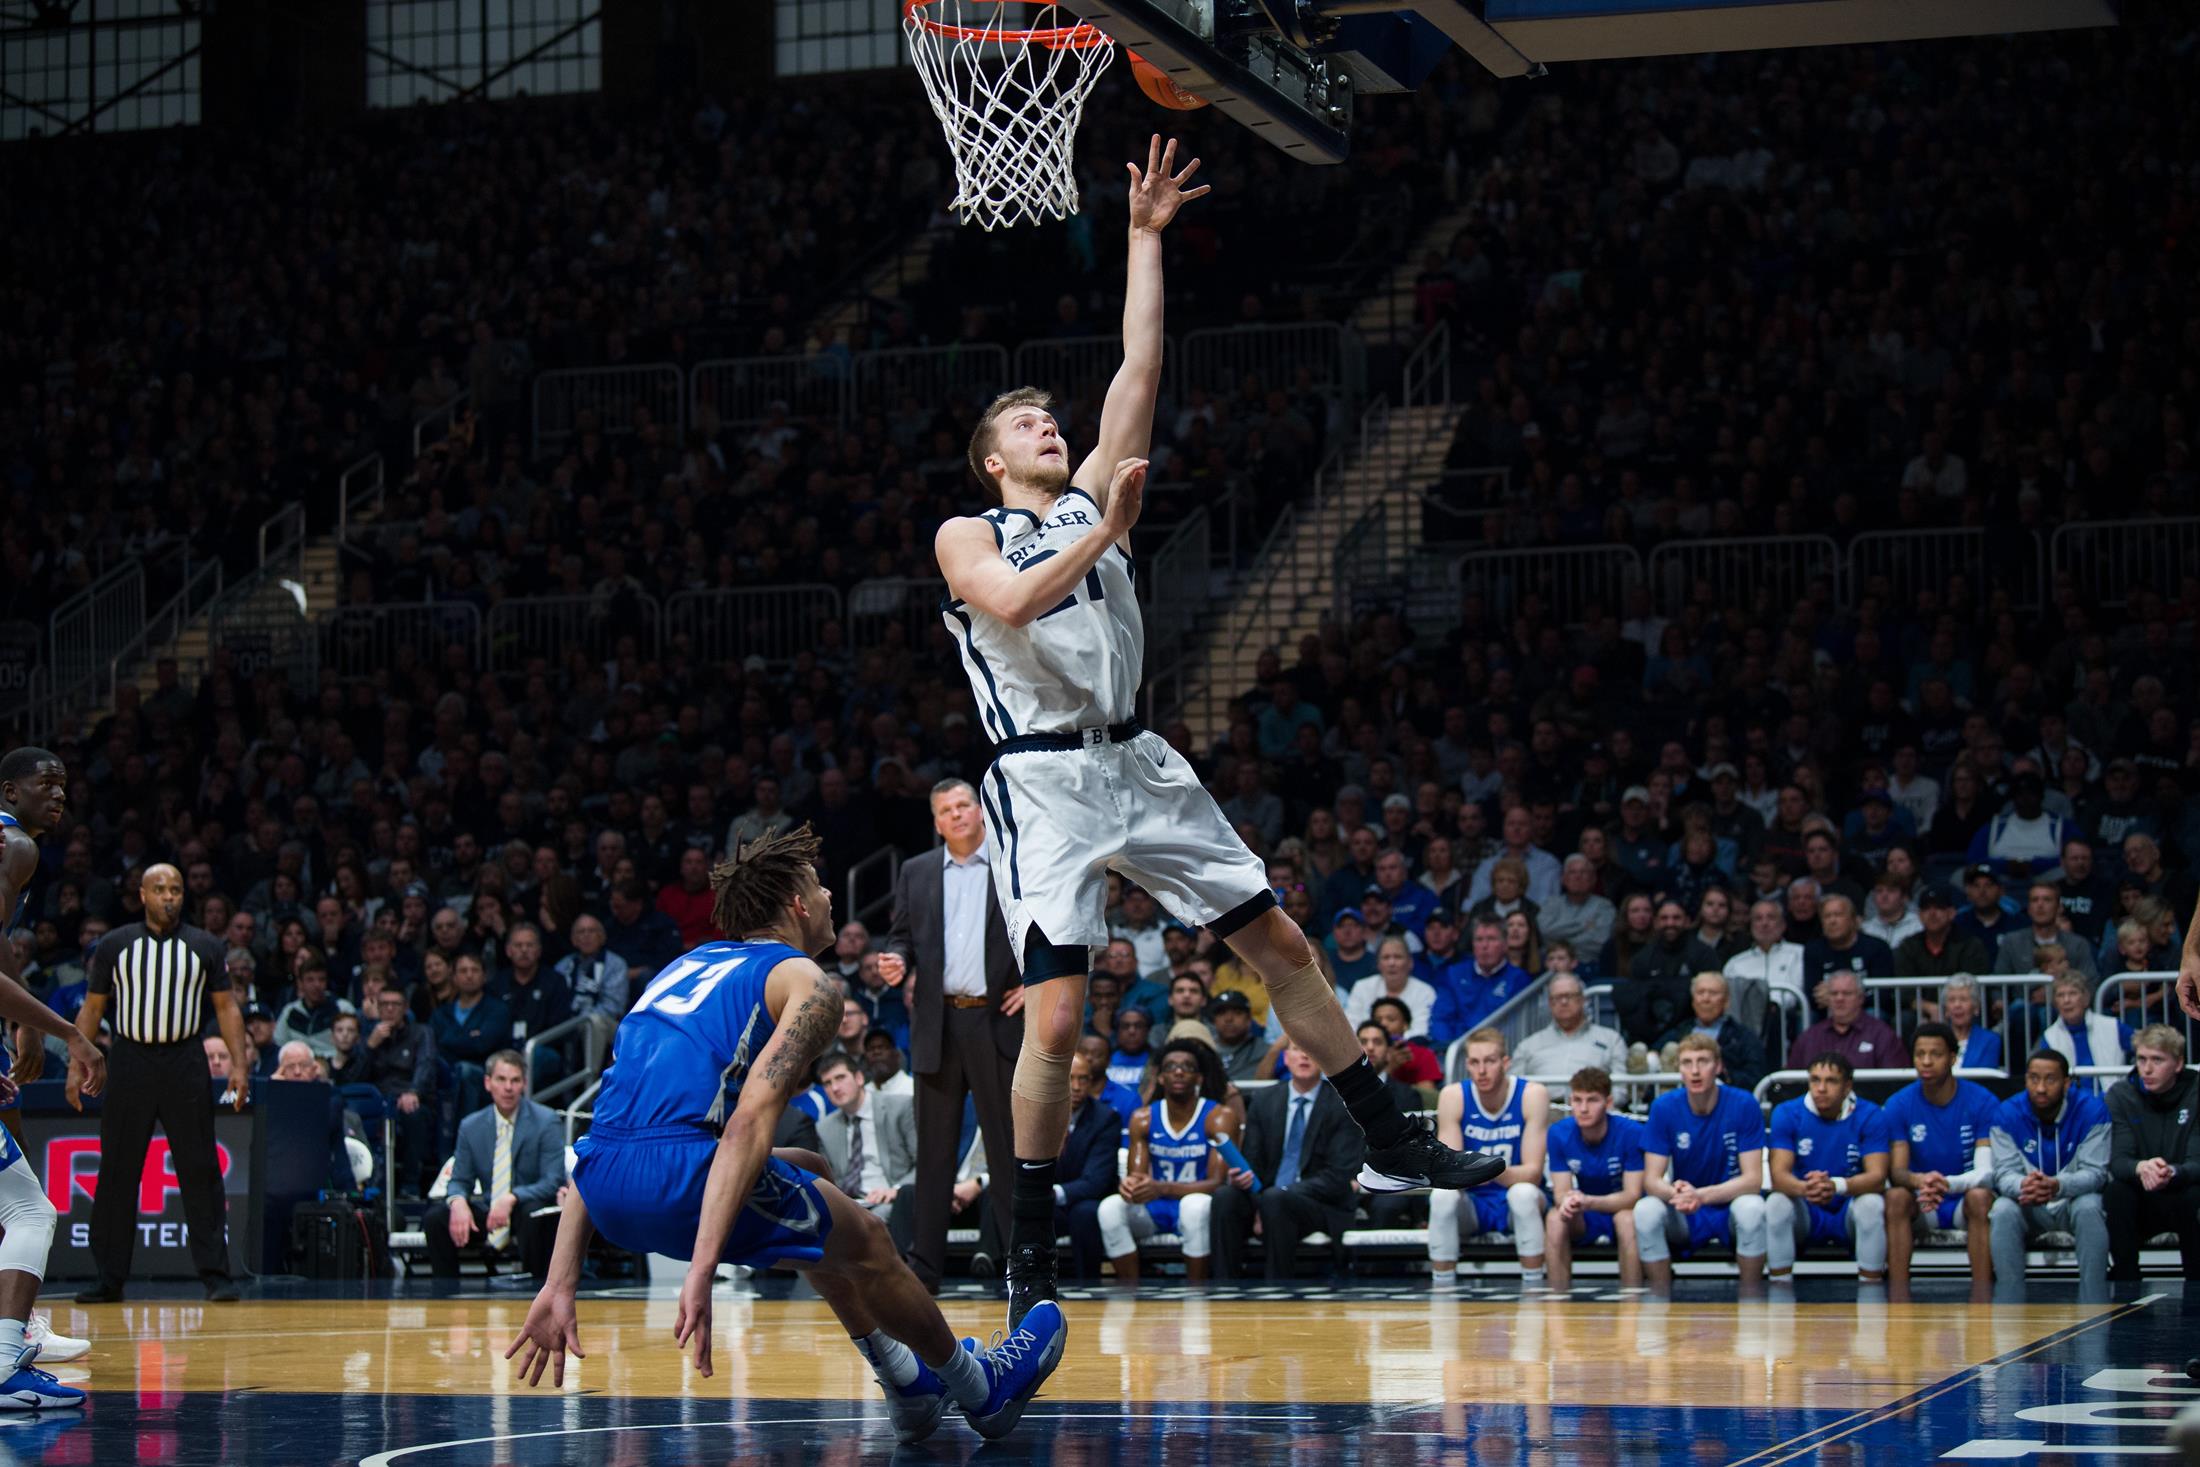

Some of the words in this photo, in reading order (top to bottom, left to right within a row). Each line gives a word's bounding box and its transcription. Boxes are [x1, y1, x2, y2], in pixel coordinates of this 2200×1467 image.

[1092, 729, 1103, 744] B
[629, 957, 749, 1015] 13
[1158, 1160, 1198, 1184] 34
